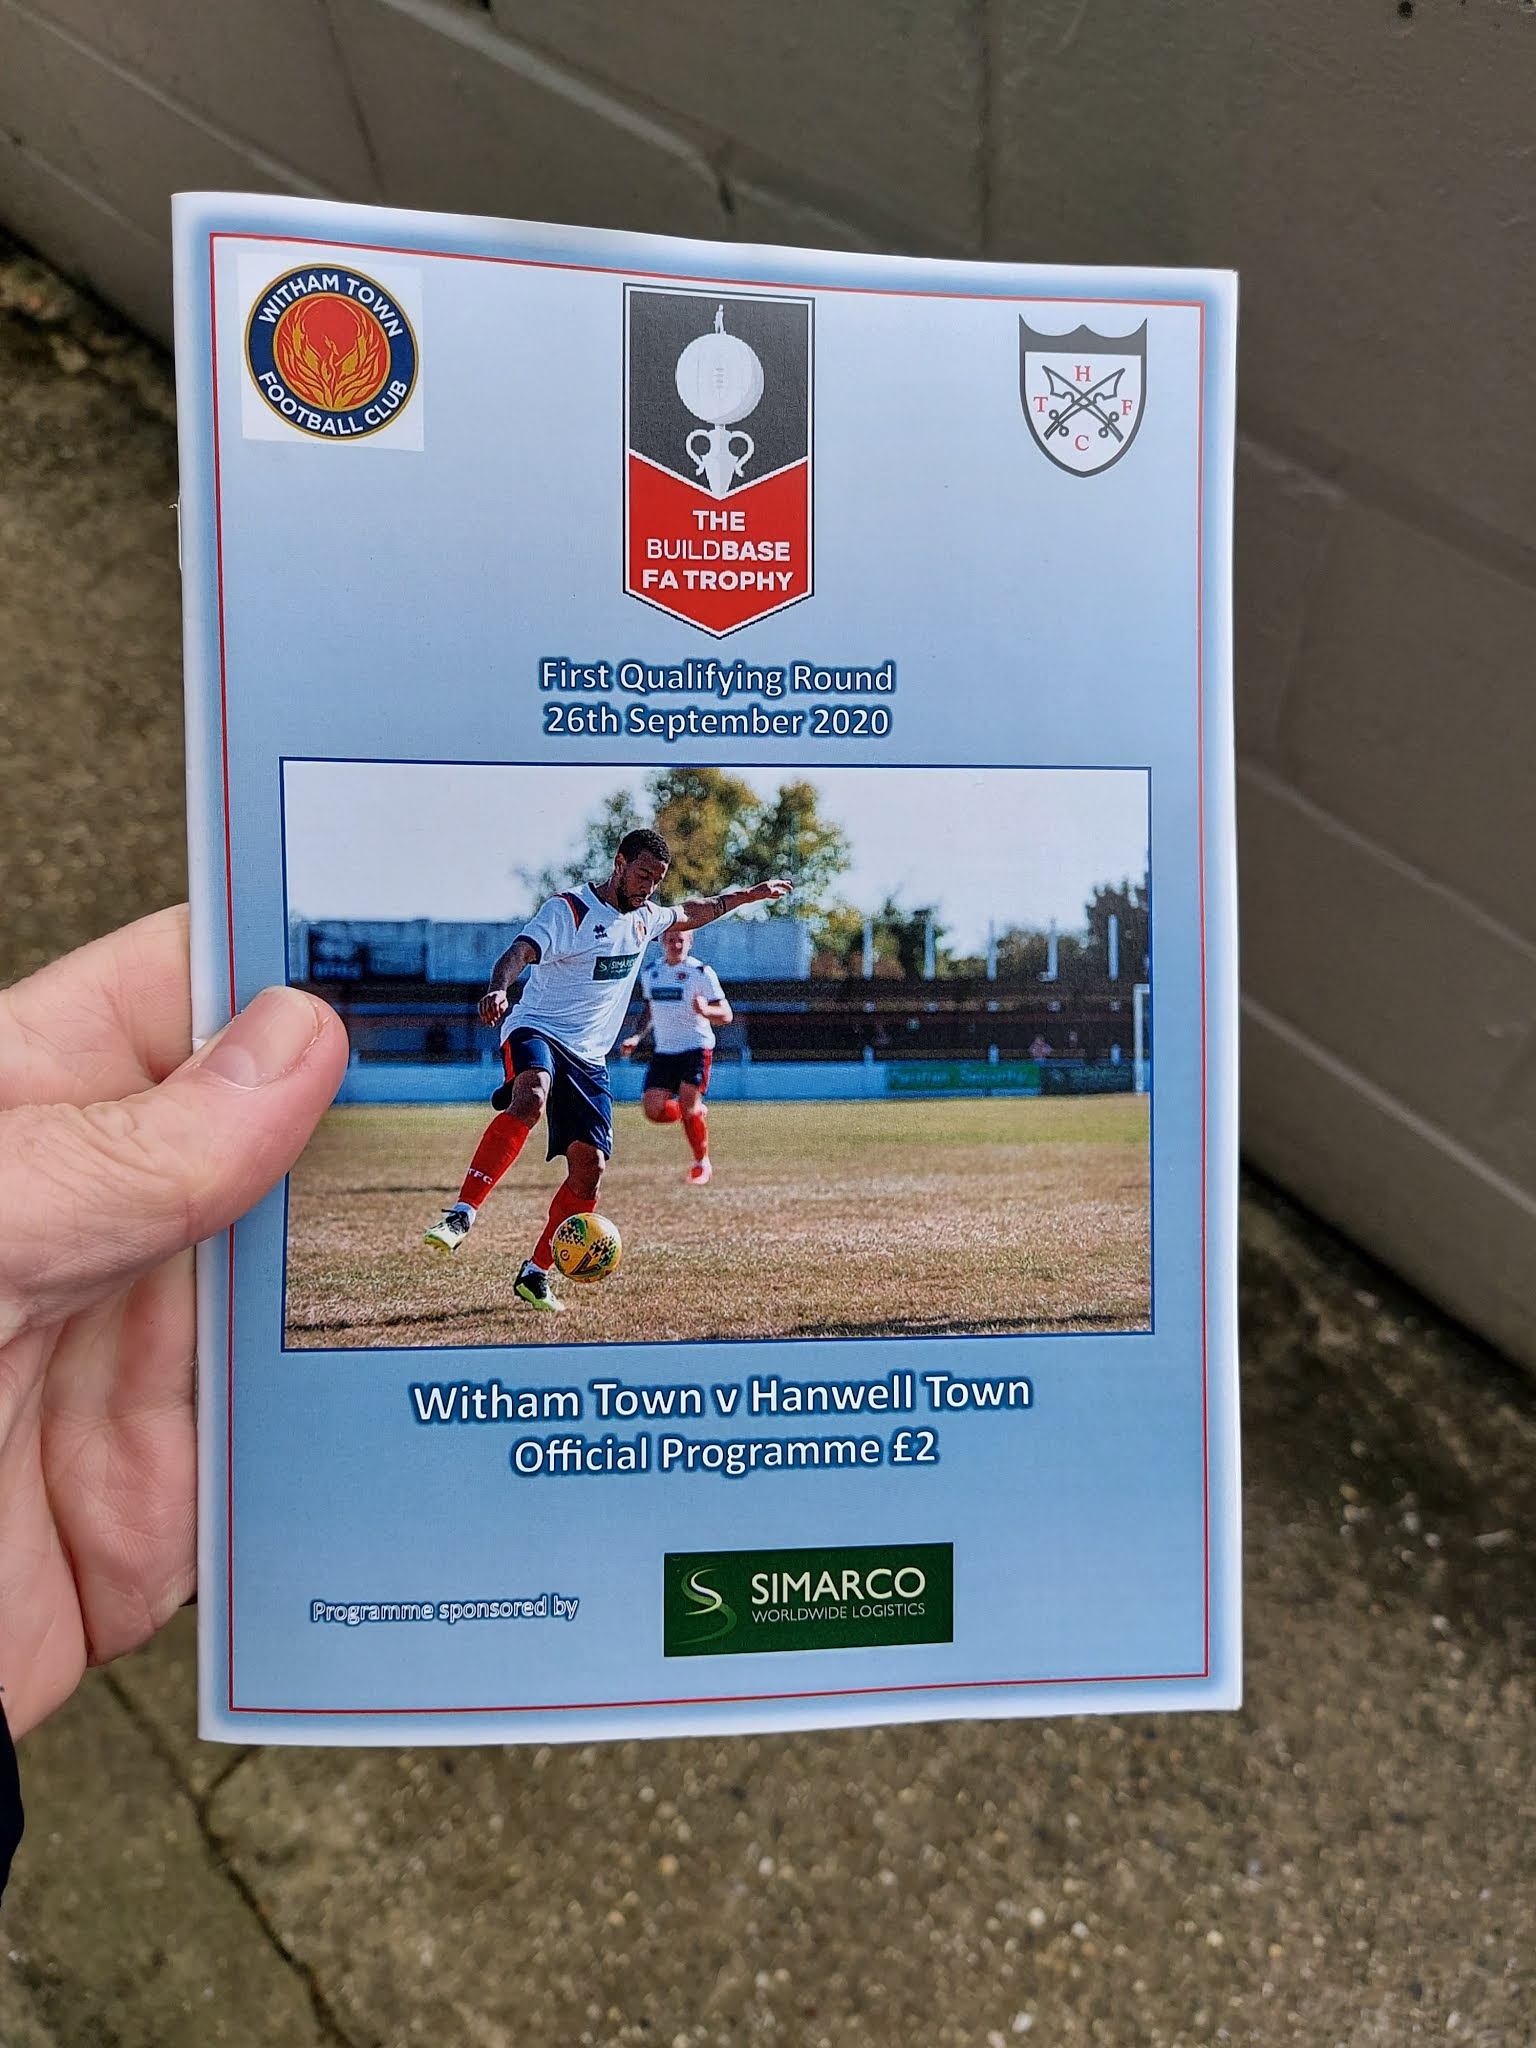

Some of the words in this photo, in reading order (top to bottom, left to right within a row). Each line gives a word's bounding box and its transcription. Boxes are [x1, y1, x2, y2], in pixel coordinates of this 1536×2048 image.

[258, 274, 340, 324] WITHAM
[346, 277, 404, 338] TOWN
[1074, 365, 1092, 383] H
[258, 370, 364, 435] FOOTBALL
[364, 379, 408, 425] CLUB
[1033, 396, 1049, 413] T
[1121, 399, 1133, 416] F
[1074, 435, 1090, 451] C
[692, 510, 746, 532] THE
[646, 538, 791, 562] BUILDBASE
[642, 569, 679, 590] FA
[682, 569, 794, 592] TROPHY
[542, 661, 610, 689] First
[619, 662, 783, 697] Qualifying
[793, 664, 894, 692] Round
[547, 706, 619, 734] 26th
[628, 707, 804, 740] September
[813, 709, 890, 735] 2020
[413, 1383, 580, 1420] Witham
[593, 1382, 702, 1416] Town
[715, 1388, 738, 1413] v
[751, 1374, 912, 1413] Hanwell
[925, 1375, 1030, 1408] Town
[514, 1436, 649, 1473] Official
[662, 1438, 880, 1475] Programme
[893, 1431, 937, 1463] £2
[751, 1566, 927, 1605] SIMARCO
[312, 1600, 435, 1625] Programme
[438, 1594, 548, 1624] sponsored
[553, 1595, 579, 1620] by
[752, 1606, 848, 1624] WORLDWIDE
[852, 1602, 926, 1619] LOGISTICS
